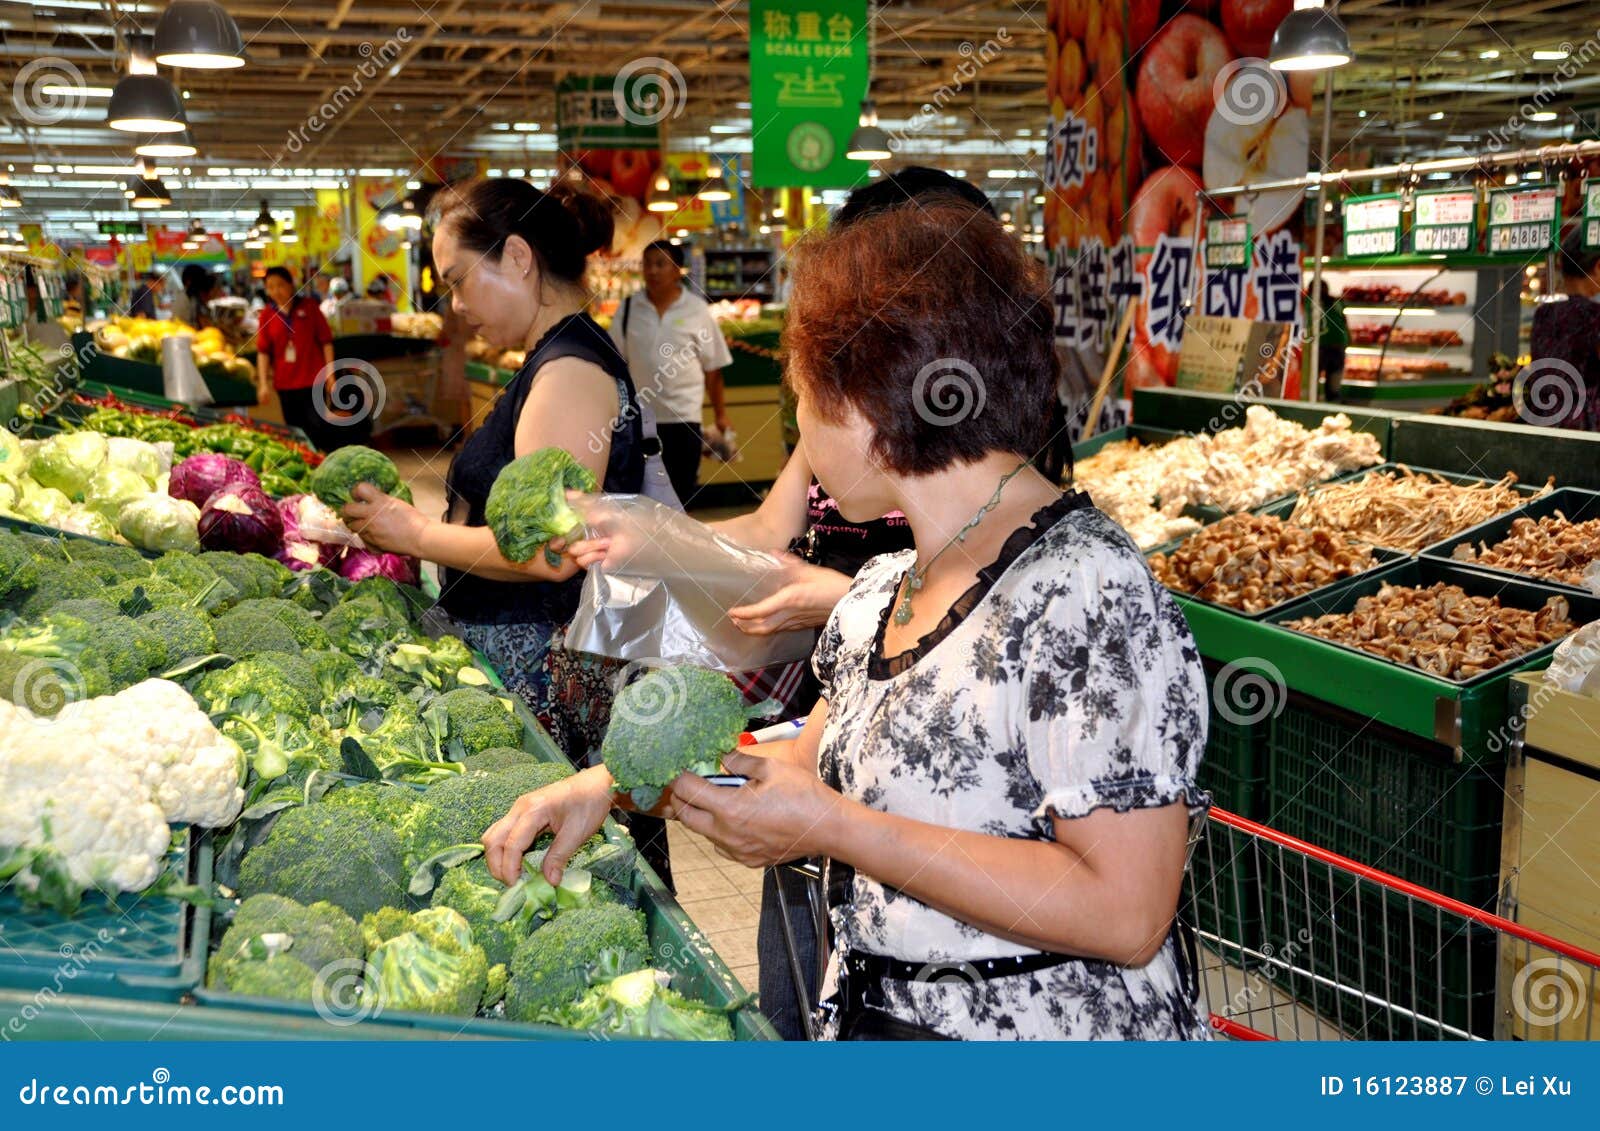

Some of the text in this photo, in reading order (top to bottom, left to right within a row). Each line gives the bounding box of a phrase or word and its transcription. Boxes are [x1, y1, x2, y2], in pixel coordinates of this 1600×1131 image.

[763, 9, 853, 42] 称重台
[765, 42, 853, 58] SCALE DESK
